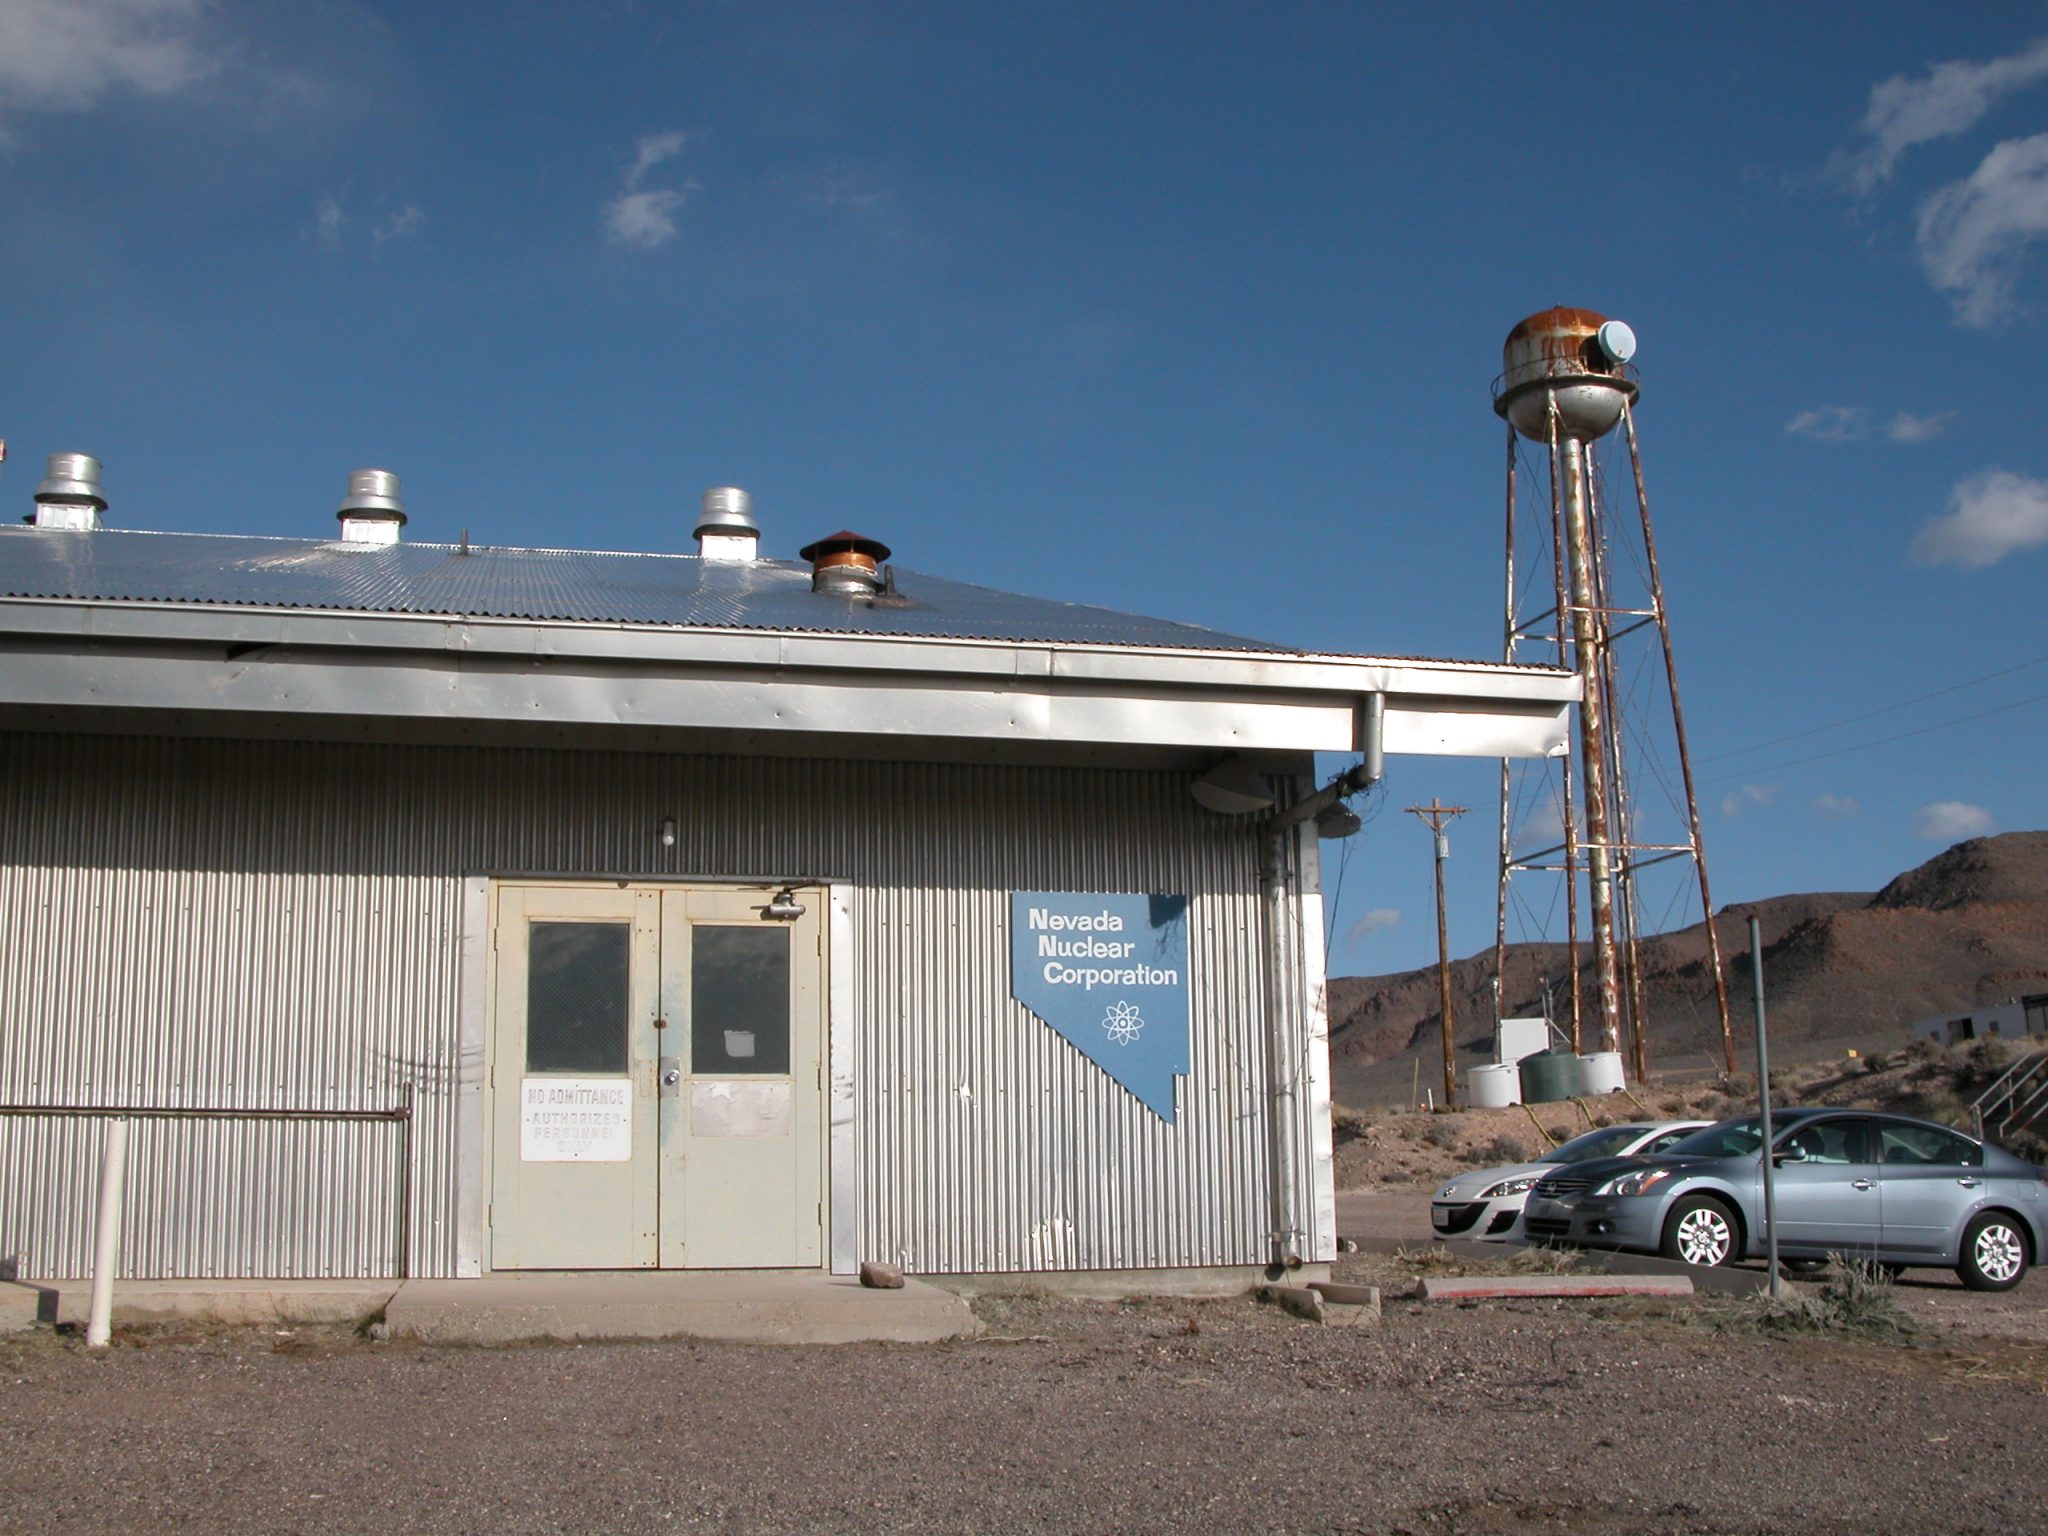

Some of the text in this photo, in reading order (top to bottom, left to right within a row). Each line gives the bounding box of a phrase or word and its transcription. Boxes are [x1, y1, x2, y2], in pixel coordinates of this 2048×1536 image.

[1029, 908, 1123, 931] Nevada
[1038, 935, 1135, 958] Nuclear
[1043, 961, 1178, 990] Corporation
[528, 1089, 624, 1104] NO ADMITTANCE
[532, 1112, 620, 1125] AUTHORIZED
[534, 1127, 616, 1139] PERSONNEL
